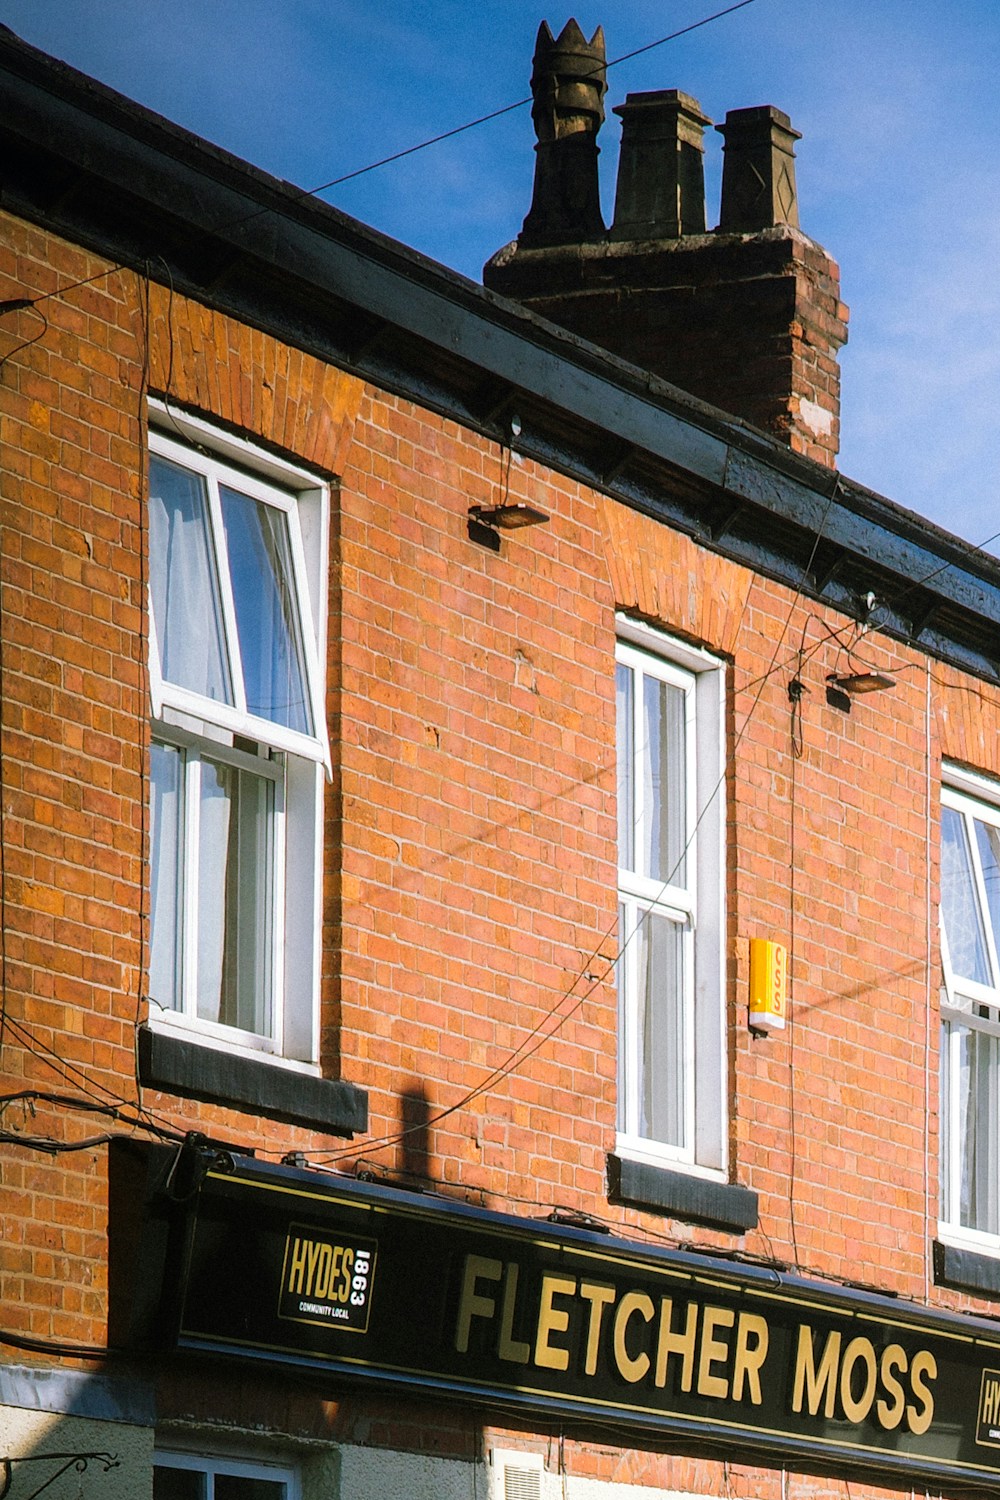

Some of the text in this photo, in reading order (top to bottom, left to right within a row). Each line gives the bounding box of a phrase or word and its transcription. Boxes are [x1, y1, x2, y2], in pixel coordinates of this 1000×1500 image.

[774, 946, 782, 1011] CSS
[288, 1237, 354, 1303] HYDES
[350, 1249, 371, 1306] 1863
[299, 1301, 350, 1320] COMMUNITY LOCAL
[456, 1253, 938, 1436] FLETCHER MOSS
